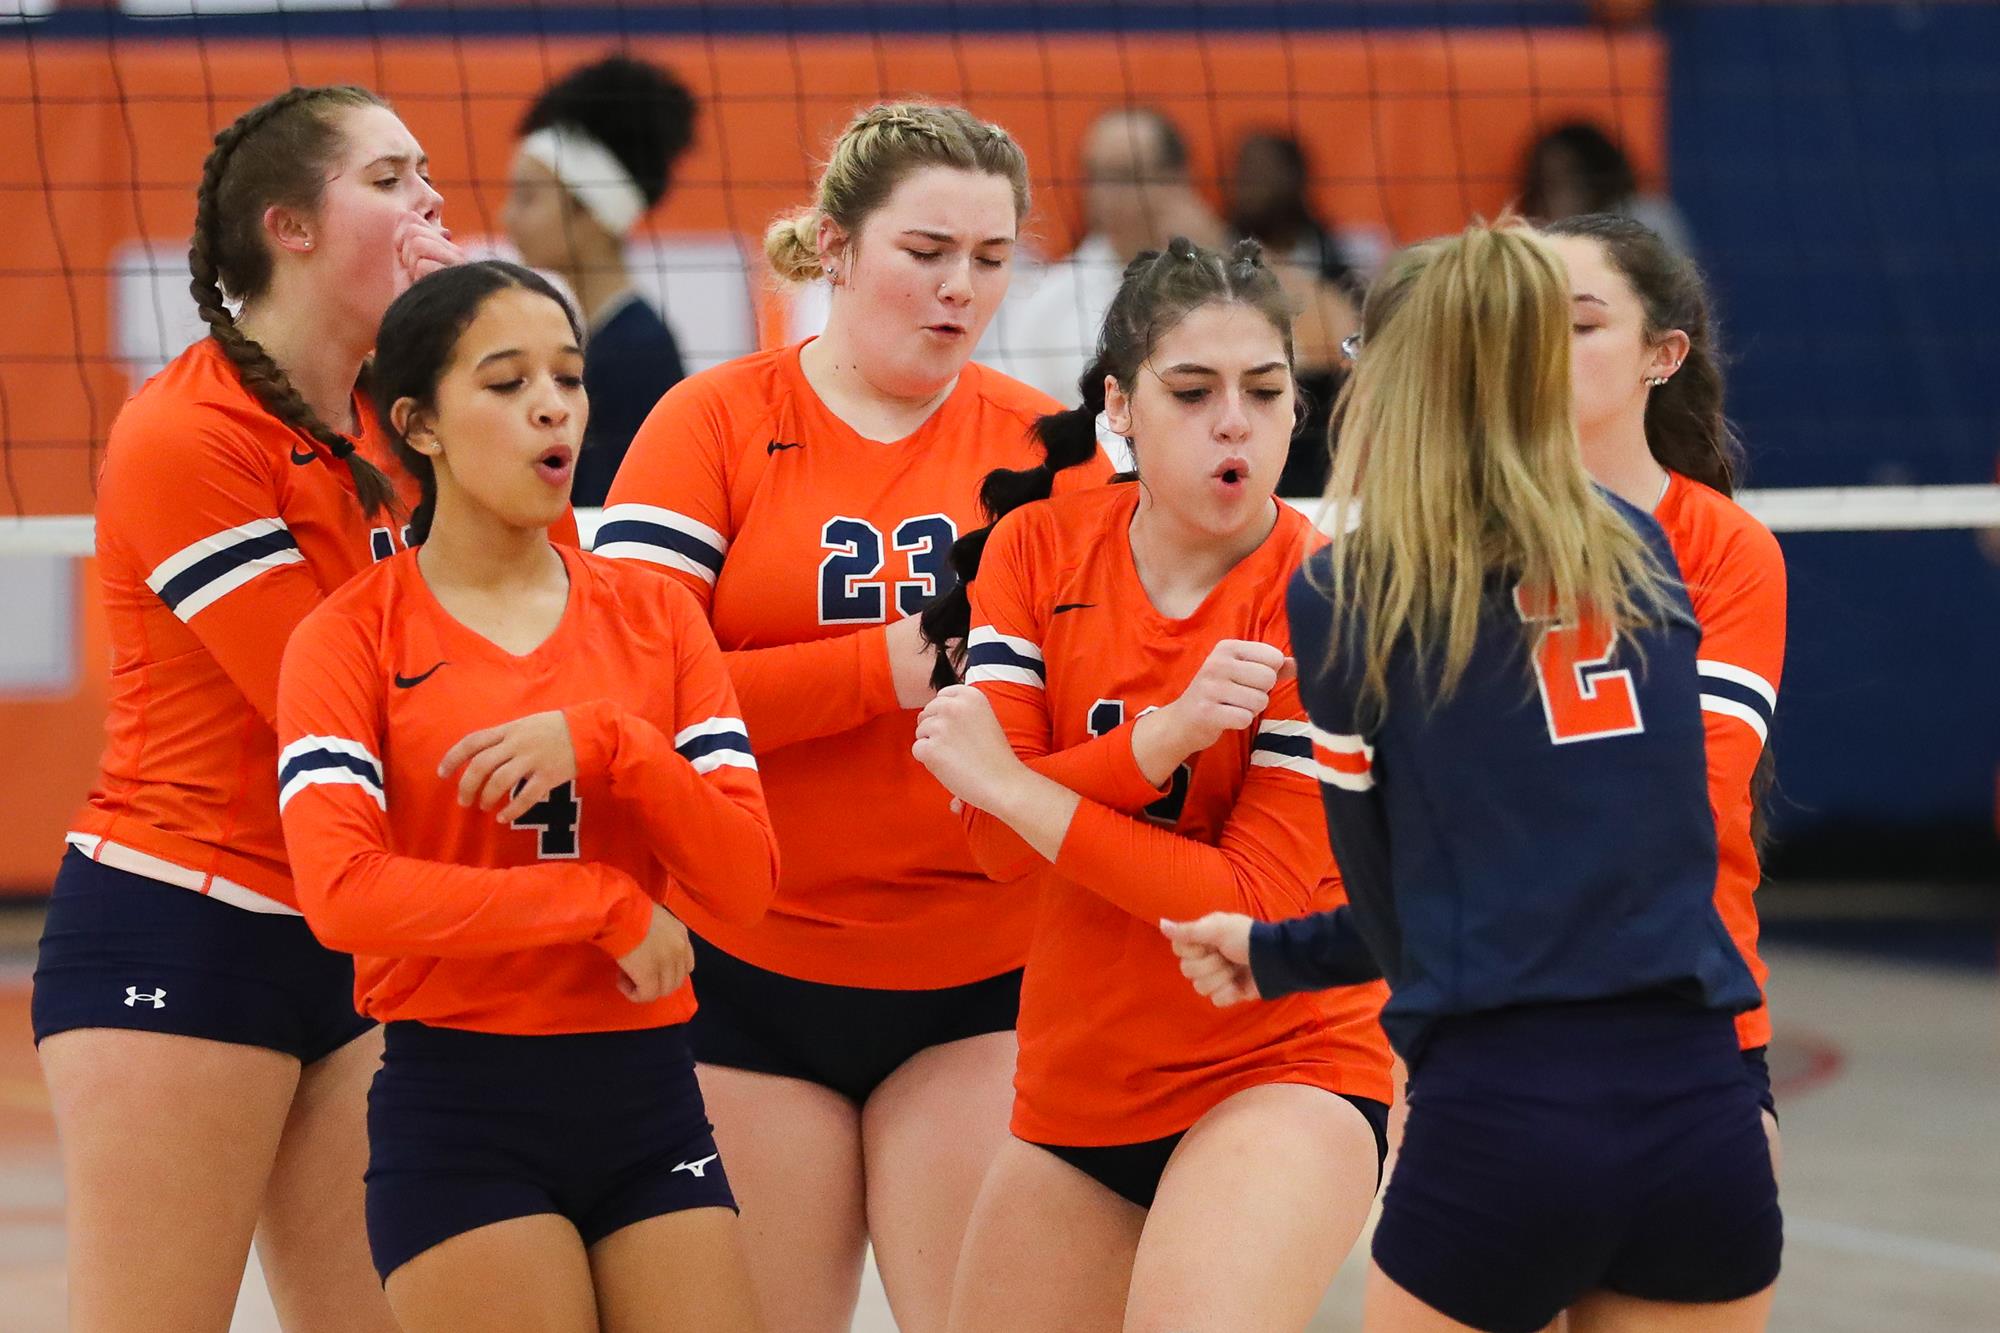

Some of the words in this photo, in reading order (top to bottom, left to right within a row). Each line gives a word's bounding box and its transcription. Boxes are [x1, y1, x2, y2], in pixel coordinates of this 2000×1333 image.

[817, 513, 959, 625] 23
[1512, 577, 1645, 745] 2
[510, 774, 582, 860] 4
